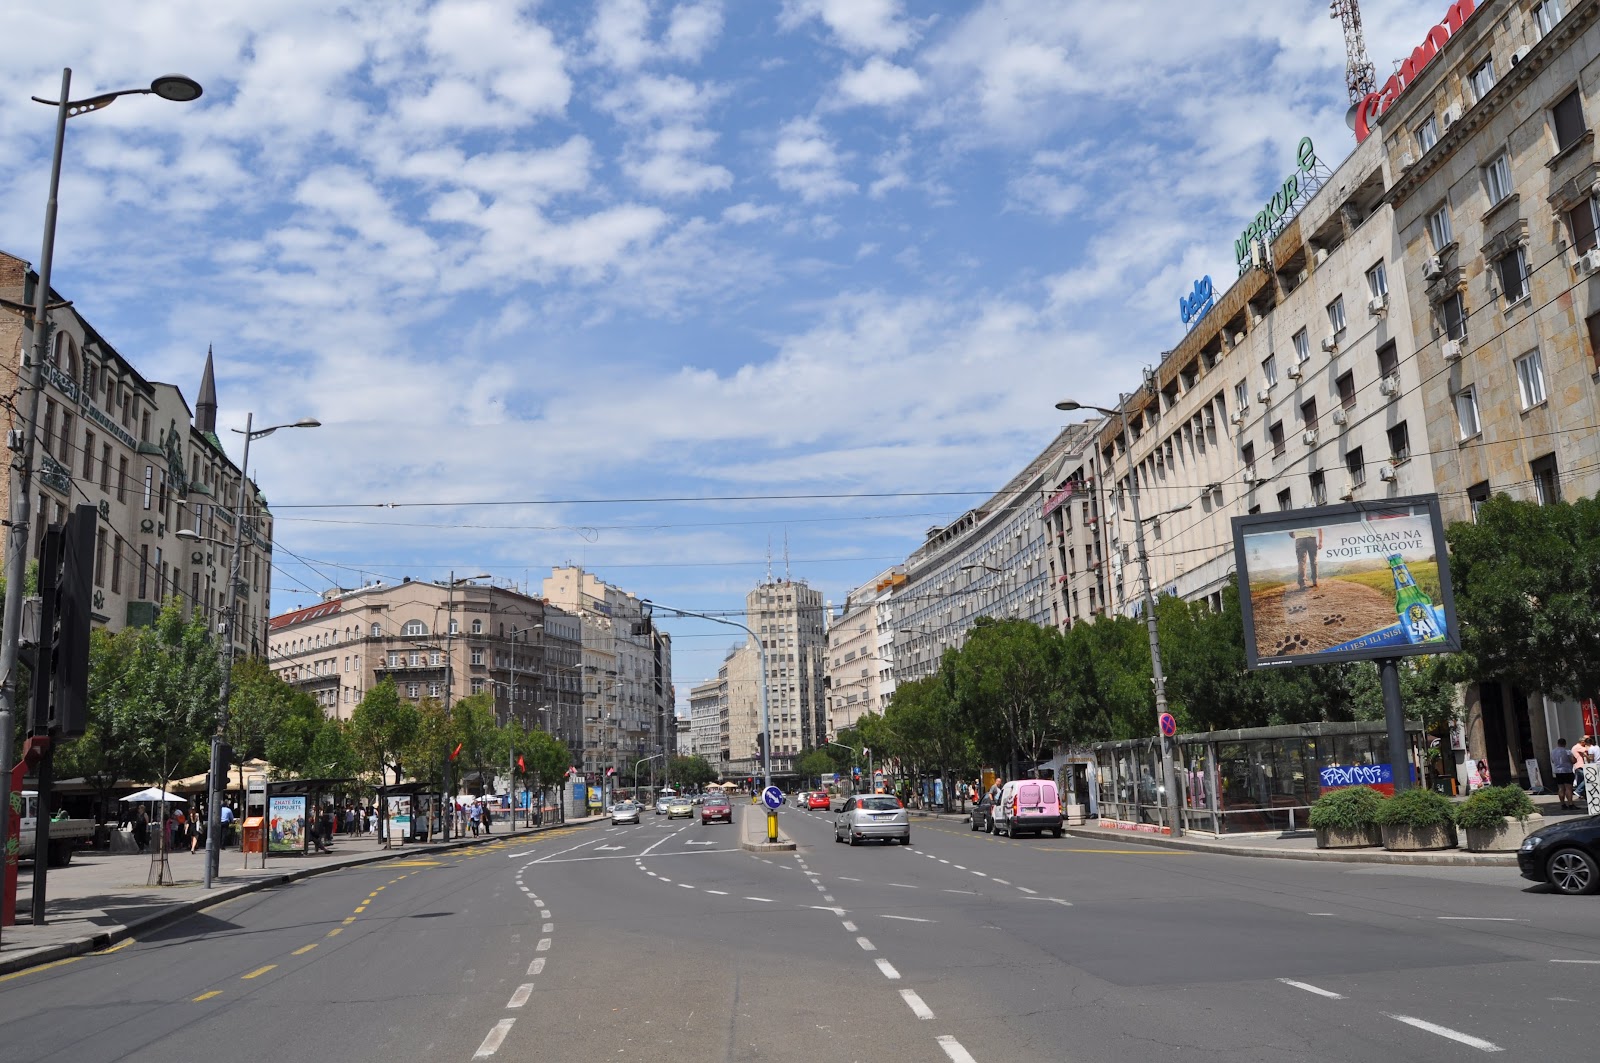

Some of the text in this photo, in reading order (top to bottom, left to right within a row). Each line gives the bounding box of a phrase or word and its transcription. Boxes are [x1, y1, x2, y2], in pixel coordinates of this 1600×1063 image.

[1179, 274, 1213, 324] beko
[1341, 529, 1422, 546] PONOSAN NA
[1326, 540, 1423, 558] SVOJE TRAGOVE
[1369, 635, 1381, 643] ILI
[1383, 628, 1402, 639] NISI
